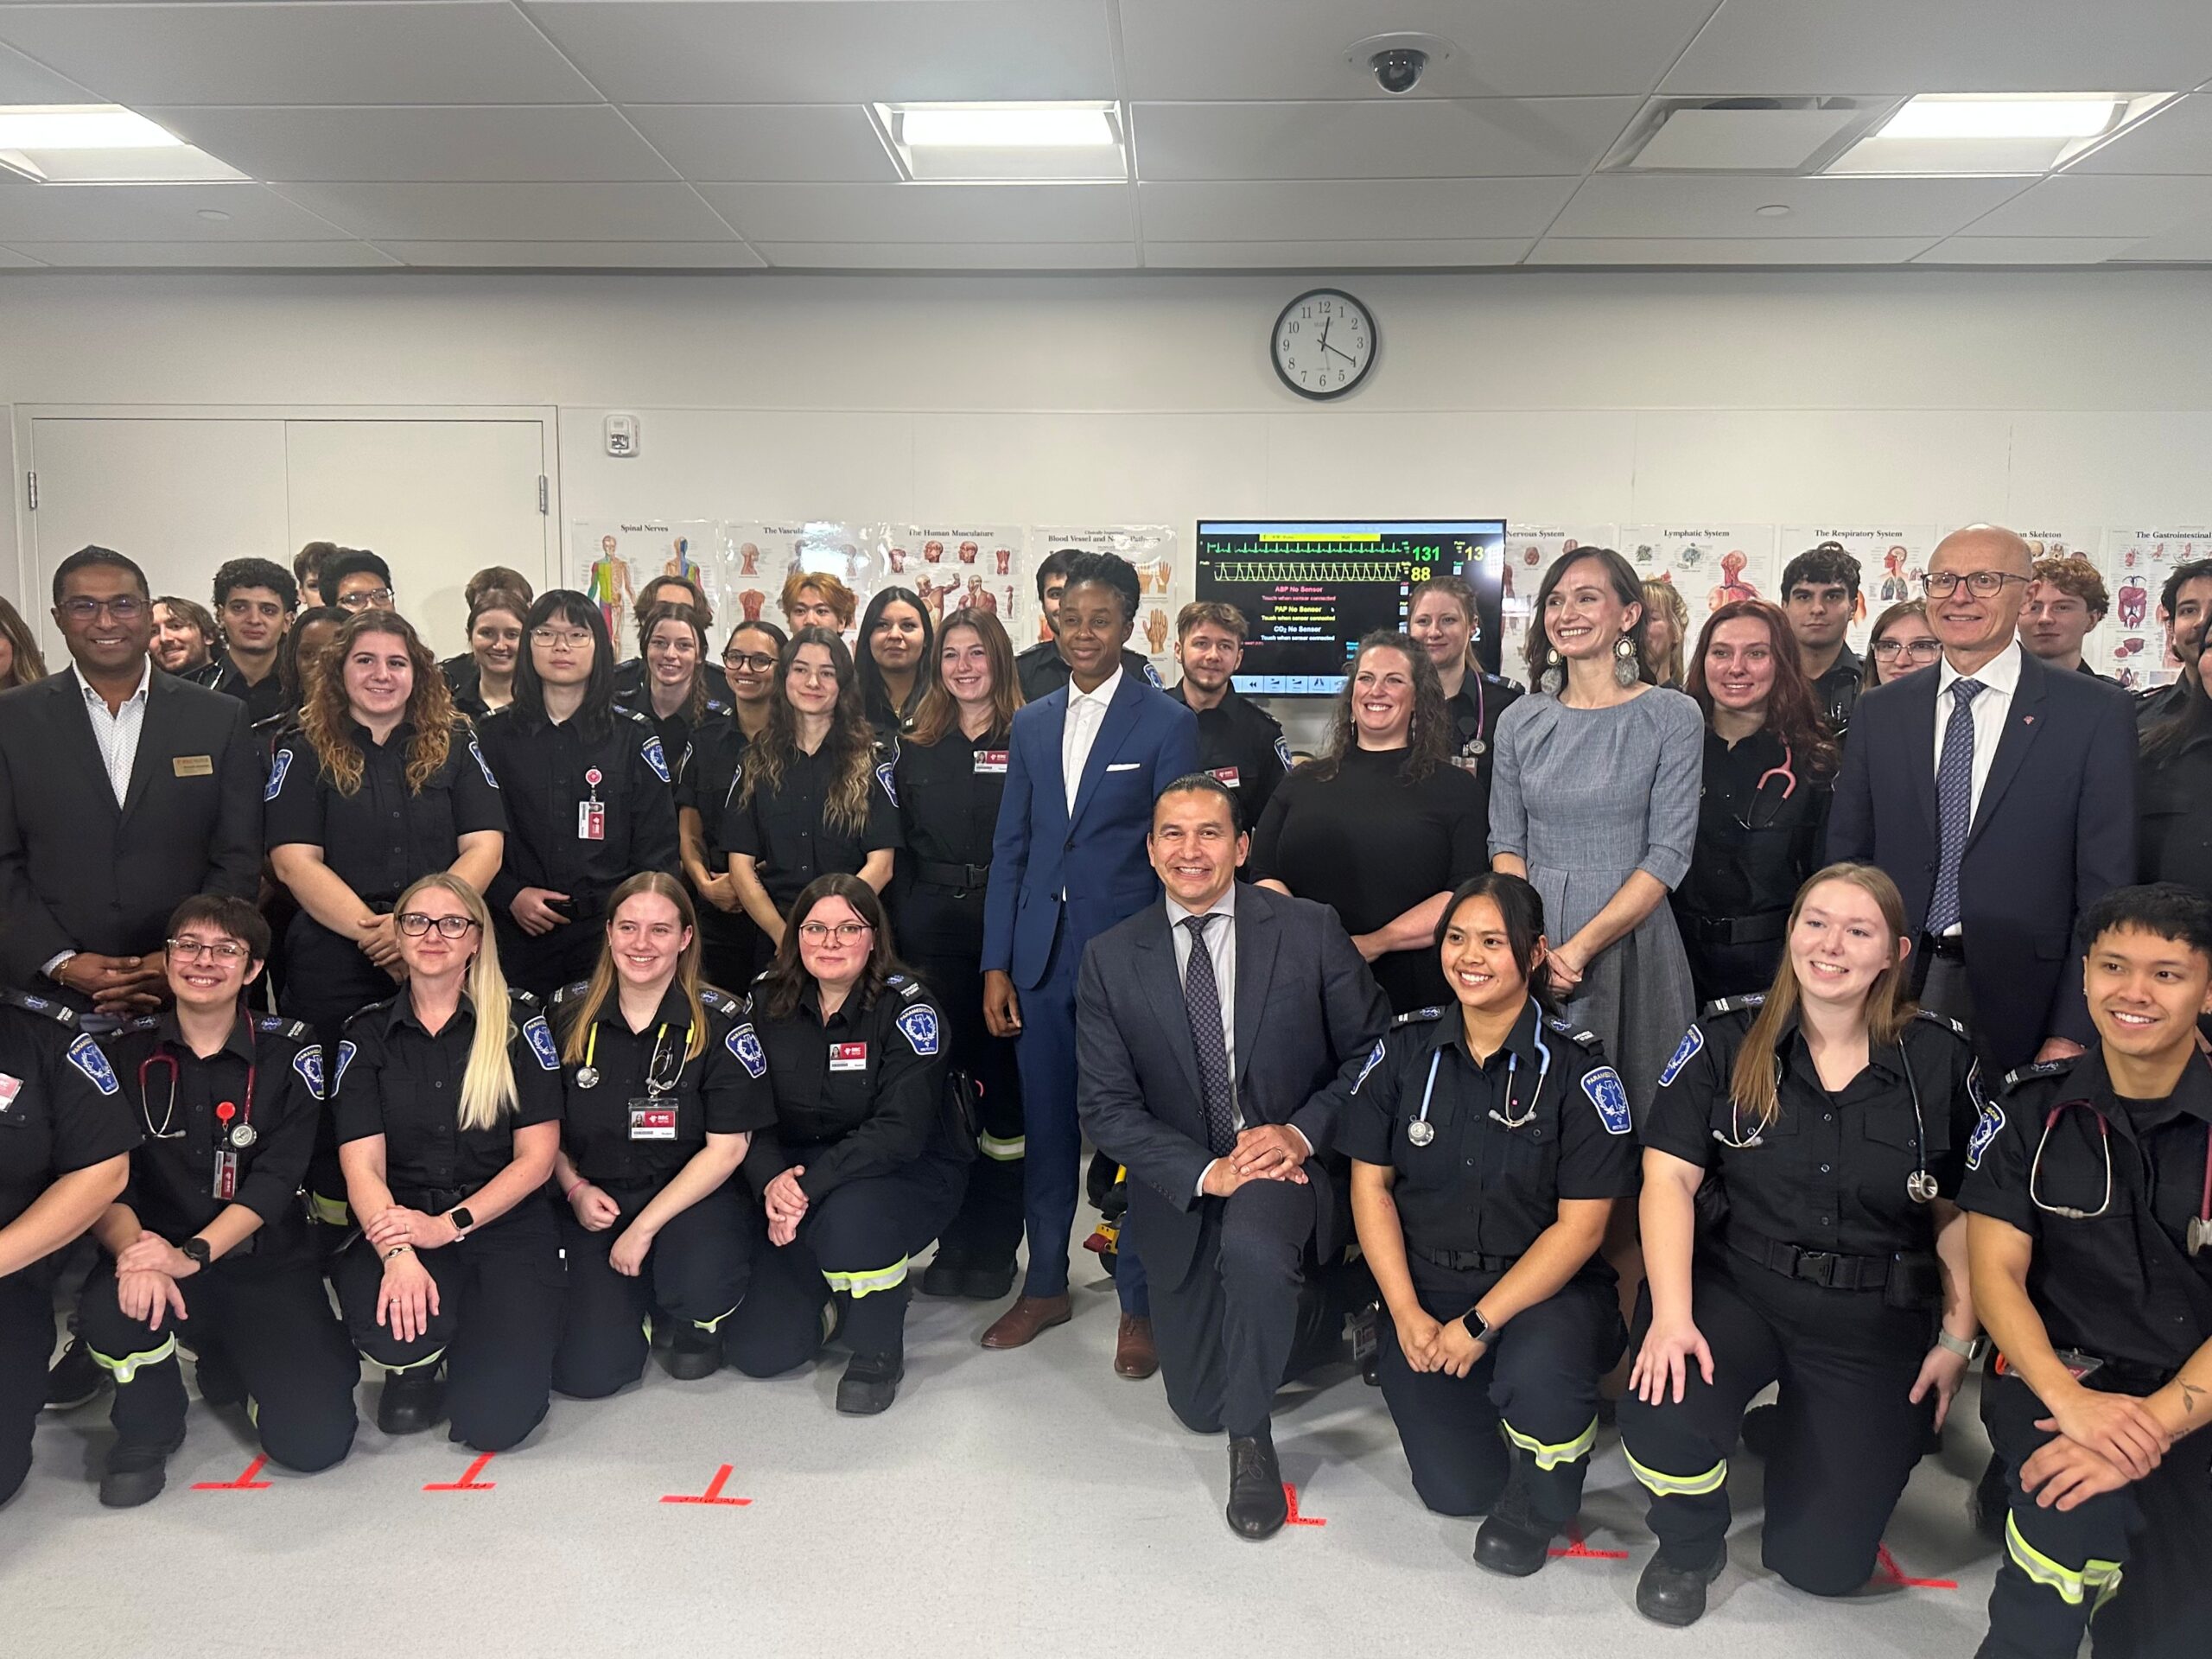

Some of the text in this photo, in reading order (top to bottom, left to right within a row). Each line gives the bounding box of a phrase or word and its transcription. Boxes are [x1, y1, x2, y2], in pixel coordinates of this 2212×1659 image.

[1301, 307, 1312, 319] 11
[1318, 301, 1331, 314] 12
[1339, 306, 1344, 318] 1
[1287, 321, 1300, 334] 10
[1351, 317, 1358, 330] 2
[1283, 339, 1290, 352] 9
[1357, 336, 1363, 349] 3
[1287, 357, 1295, 370] 8
[1300, 370, 1307, 383] 7
[1319, 374, 1326, 387] 6
[1338, 369, 1345, 382] 5
[620, 524, 669, 533] Spinal Nerves
[1539, 530, 1565, 539] System
[1664, 530, 1730, 539] Lymphatic System
[1832, 530, 1874, 539] Respiratory
[1877, 530, 1903, 539] System
[1412, 546, 1440, 561] 131
[1410, 566, 1431, 582] 88
